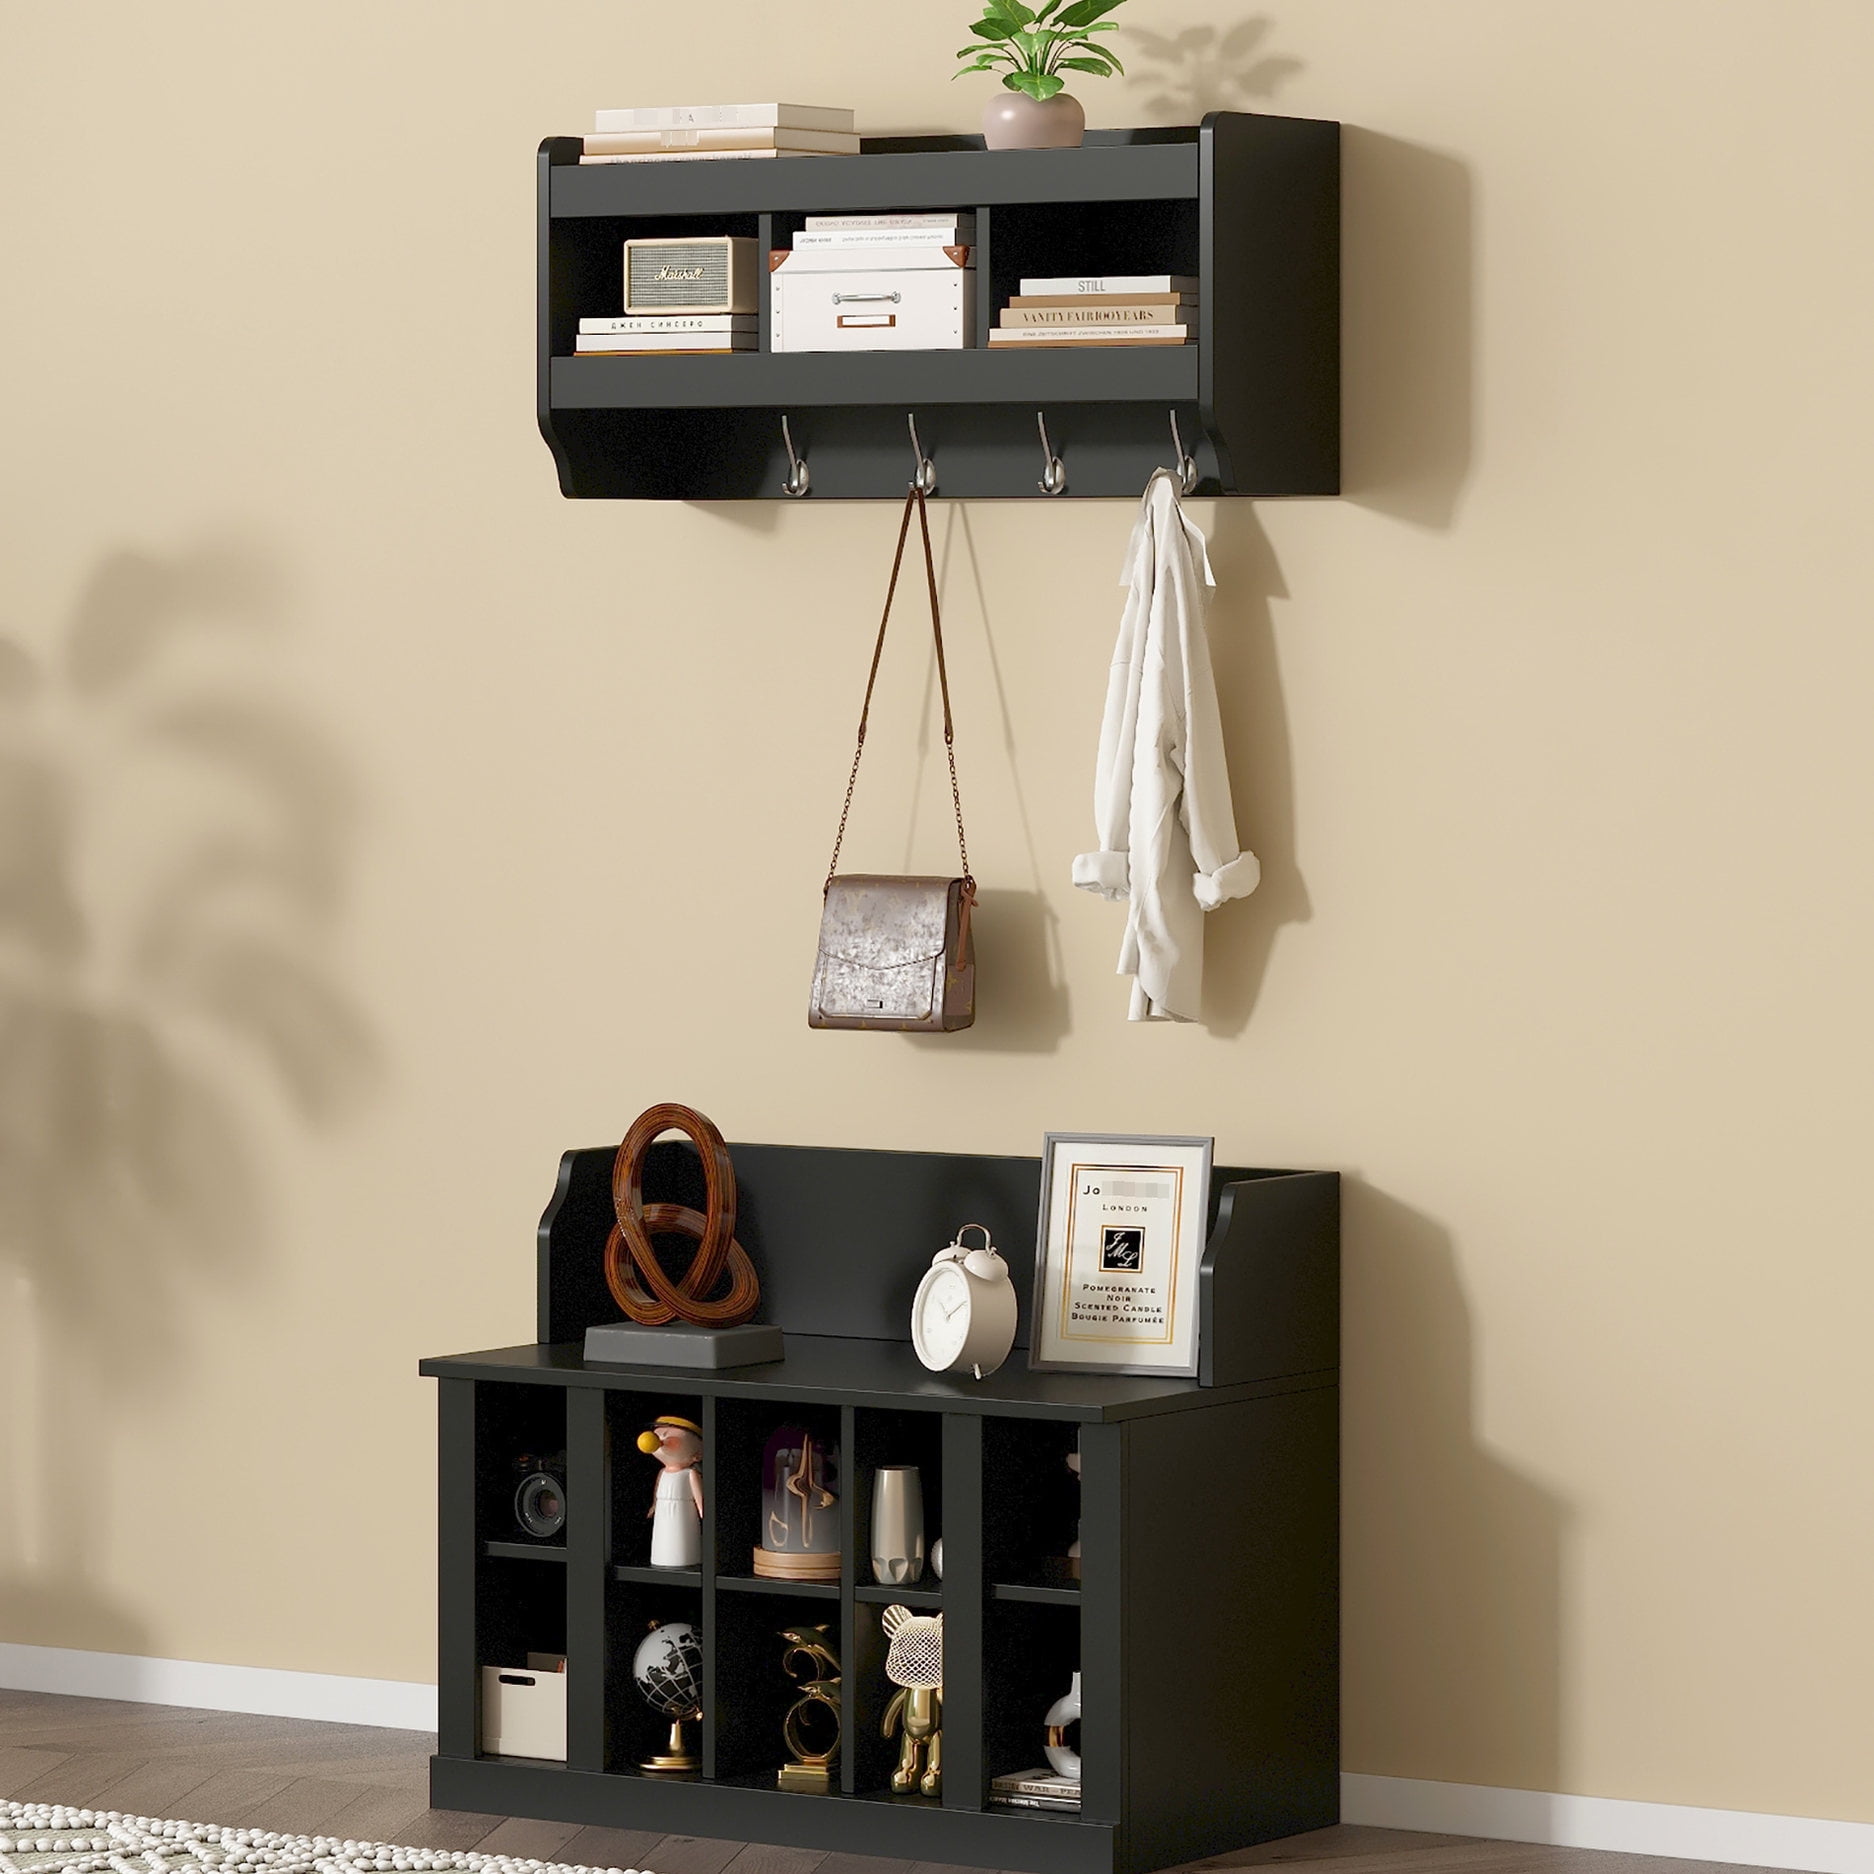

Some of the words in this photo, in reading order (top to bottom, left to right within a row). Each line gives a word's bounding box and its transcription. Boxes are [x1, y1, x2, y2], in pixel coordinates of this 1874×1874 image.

[655, 265, 704, 280] Marshall
[1078, 280, 1106, 292] STILL
[1102, 1204, 1148, 1212] LONDON
[1082, 1284, 1156, 1294] POMEGRANATE
[1106, 1294, 1132, 1302] NOIR
[1074, 1301, 1119, 1311] SCENTED
[1123, 1304, 1162, 1313] CANDLE
[1071, 1312, 1108, 1322] BOUGIE
[1112, 1314, 1165, 1324] PARFUMÉE
